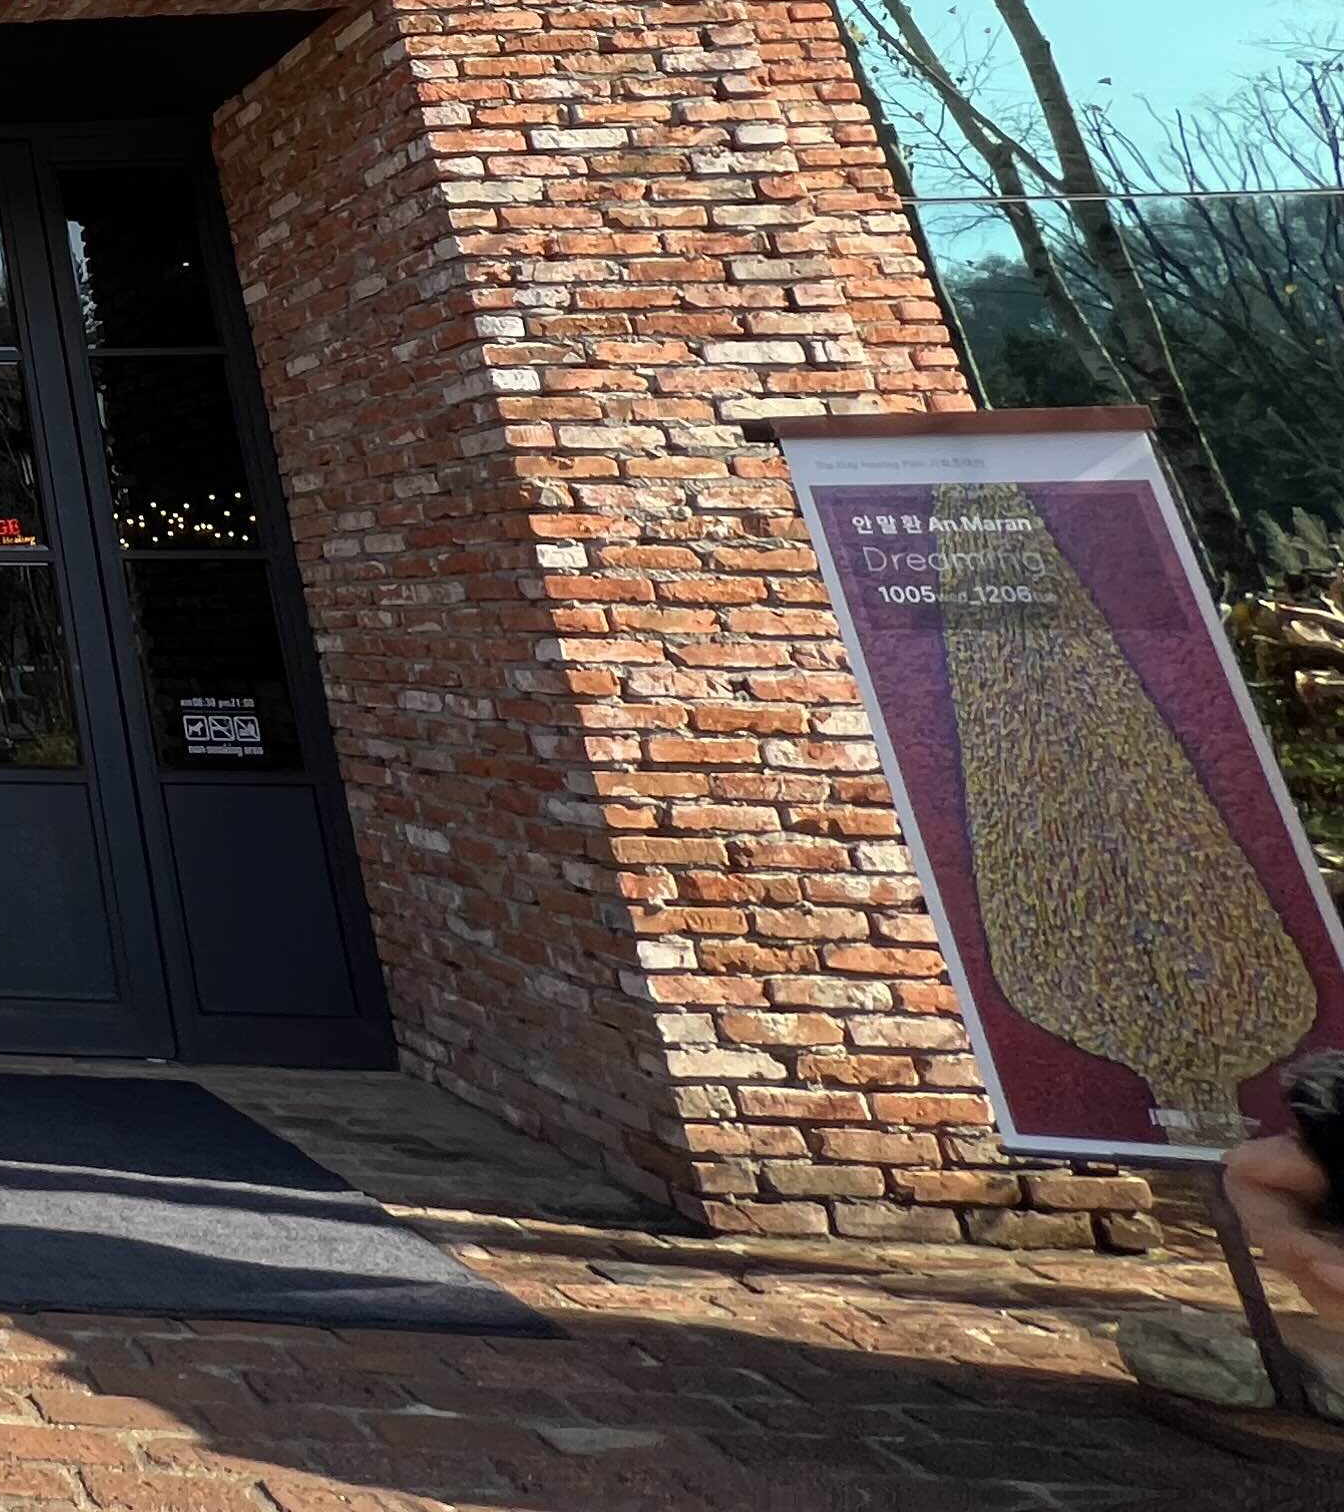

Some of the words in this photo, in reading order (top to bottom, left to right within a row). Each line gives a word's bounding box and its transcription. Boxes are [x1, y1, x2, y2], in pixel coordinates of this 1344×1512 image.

[927, 515, 958, 533] An
[961, 515, 1033, 533] Maran
[862, 546, 1047, 577] Dreaming
